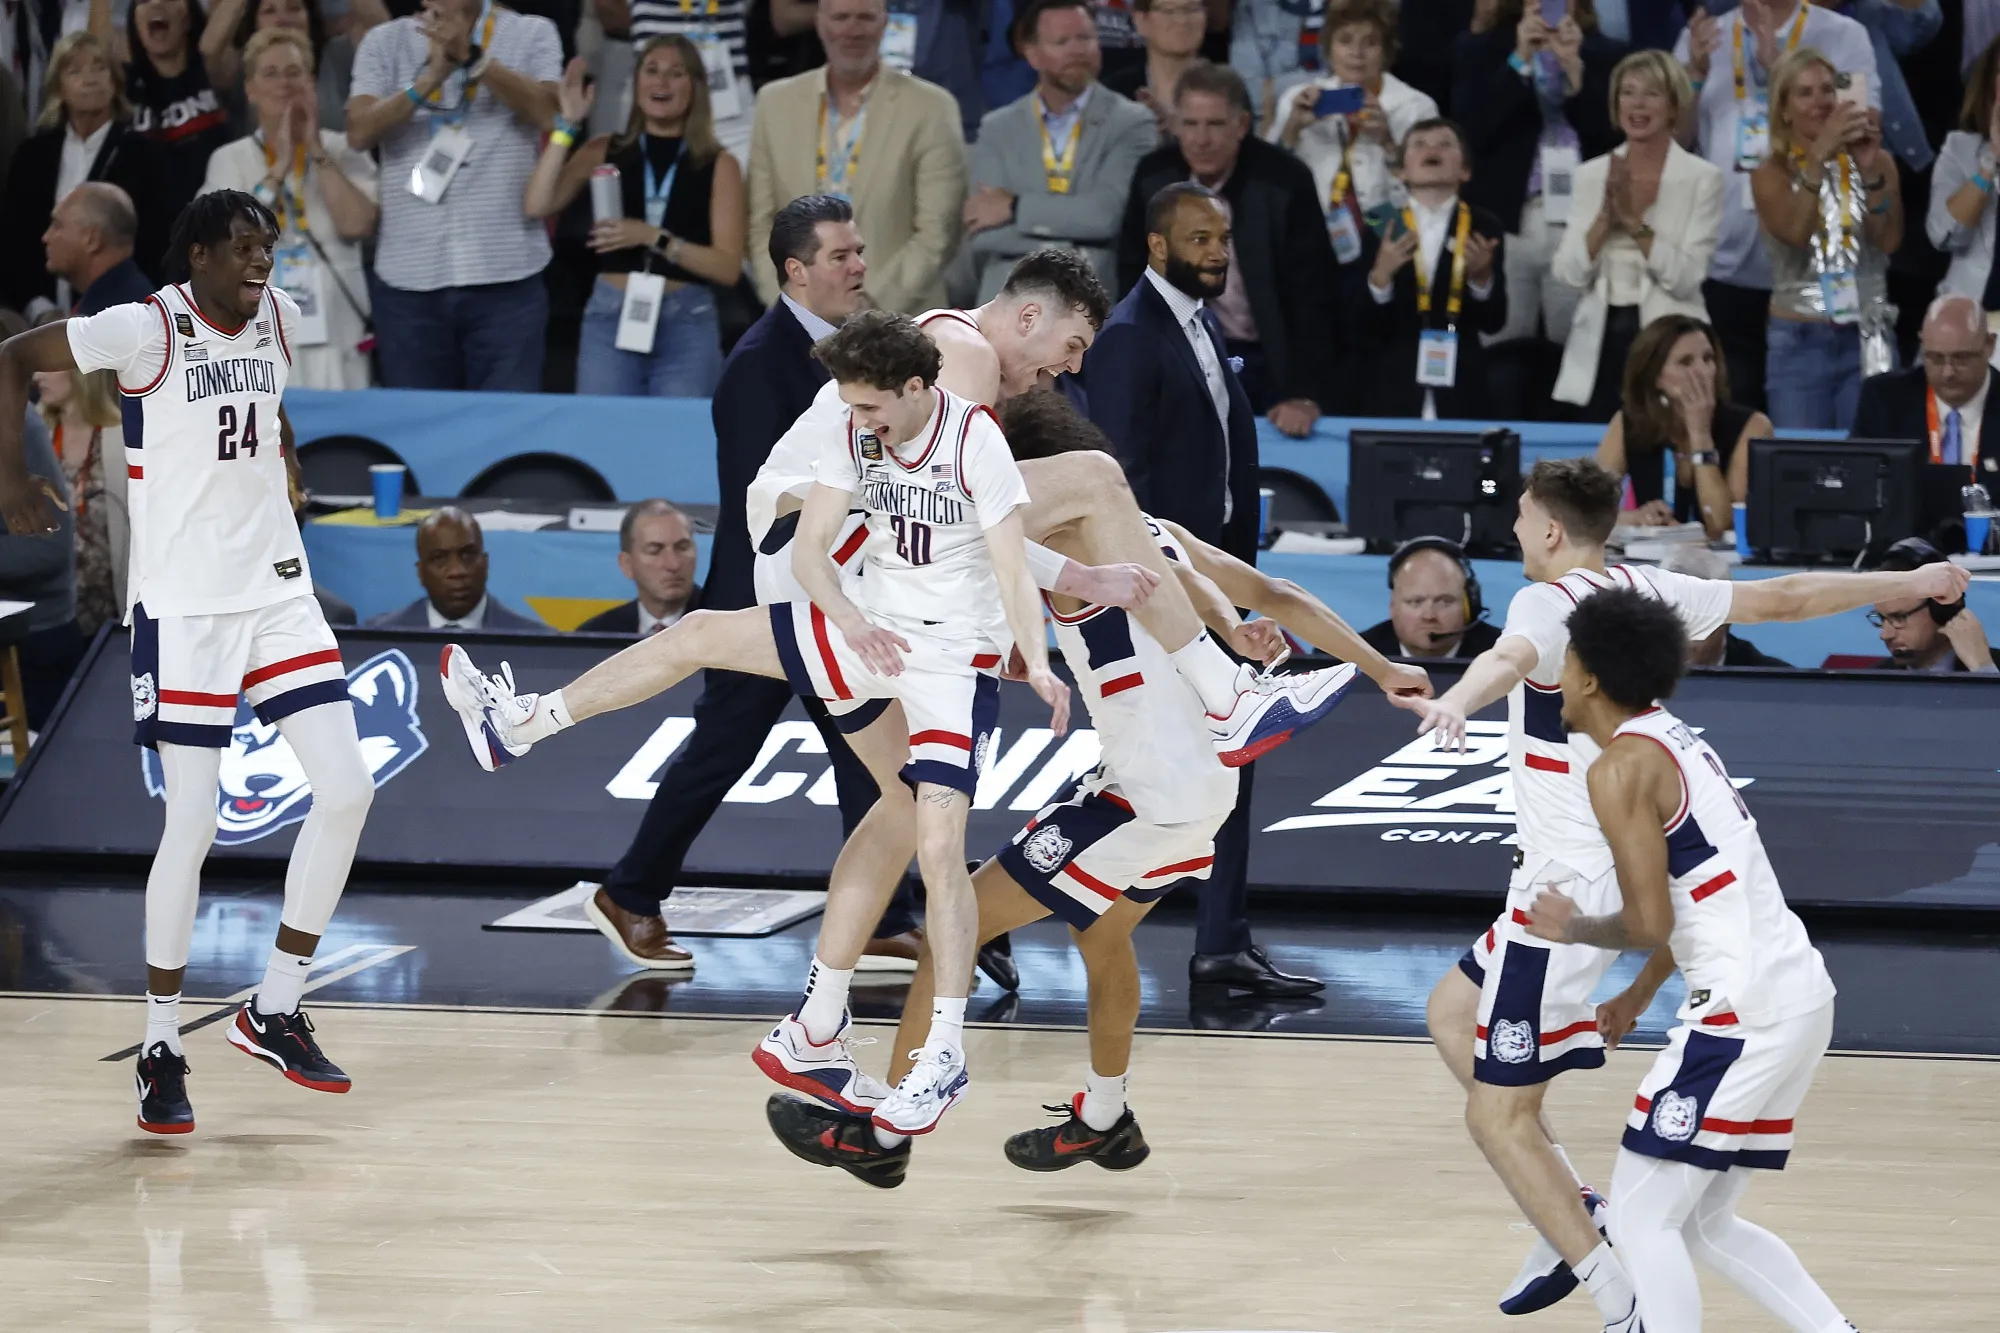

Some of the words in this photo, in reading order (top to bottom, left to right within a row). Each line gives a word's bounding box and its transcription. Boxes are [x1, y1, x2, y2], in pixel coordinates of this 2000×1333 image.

[184, 357, 277, 403] CONNECTICUT
[217, 401, 259, 461] 24
[889, 514, 932, 567] 20
